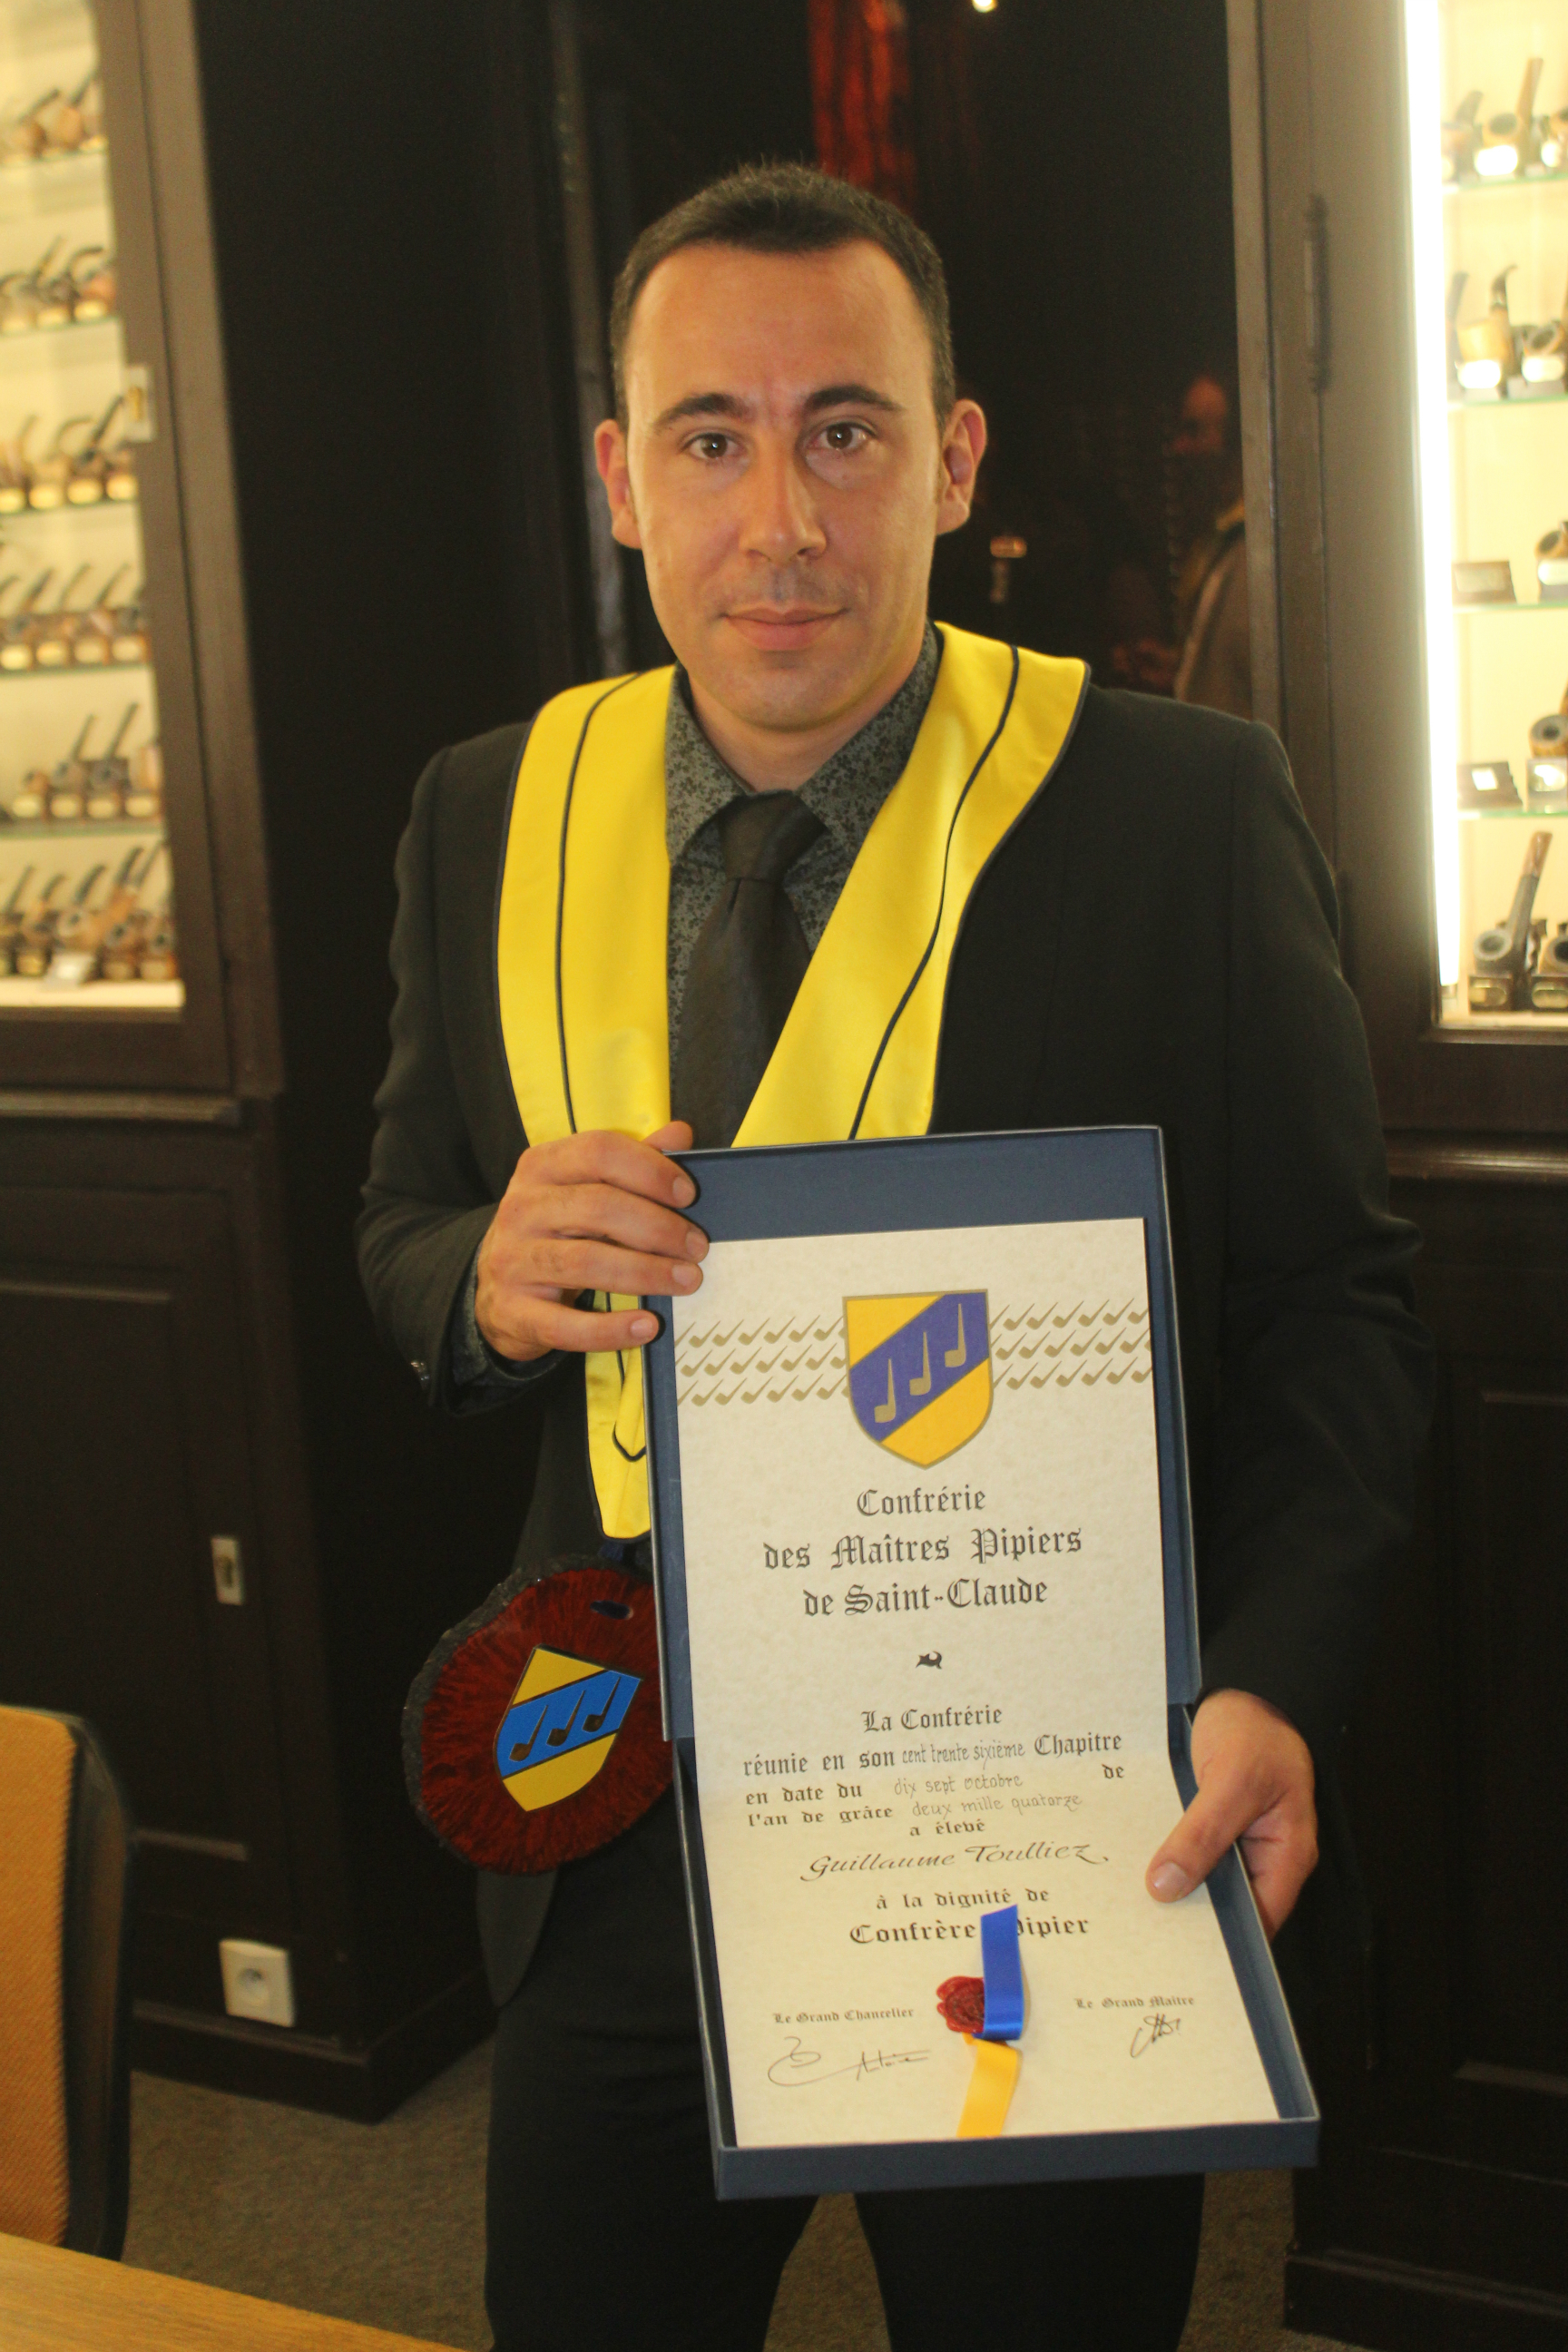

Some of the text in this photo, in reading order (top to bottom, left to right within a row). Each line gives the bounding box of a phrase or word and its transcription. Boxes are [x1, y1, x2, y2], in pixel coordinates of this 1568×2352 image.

[857, 1484, 986, 1517] Confrérie
[763, 1525, 1083, 1570] des Maîtres Pipiers
[803, 1576, 1048, 1616] de Saint-Claude
[861, 1704, 1003, 1733] La Confrérie
[743, 1752, 808, 1777] réunie
[822, 1754, 846, 1771] en
[858, 1749, 897, 1769] son
[902, 1743, 927, 1764] cent
[931, 1742, 970, 1763] trente
[1034, 1731, 1122, 1759] Chapitre
[746, 1763, 1125, 1805] en date du dix sept octobre de
[749, 1813, 789, 1828] l'an
[801, 1811, 825, 1823] de
[839, 1805, 894, 1824] grâce
[961, 1796, 1004, 1812] mille
[1011, 1793, 1083, 1816] quatorze
[909, 1818, 986, 1837] a élevé
[799, 1853, 956, 1882] Guillaume
[876, 1887, 1050, 1909] à la dignité de
[849, 1919, 976, 1944] Confrère
[1101, 1996, 1145, 2009] Grand
[796, 2011, 839, 2024] Grand
